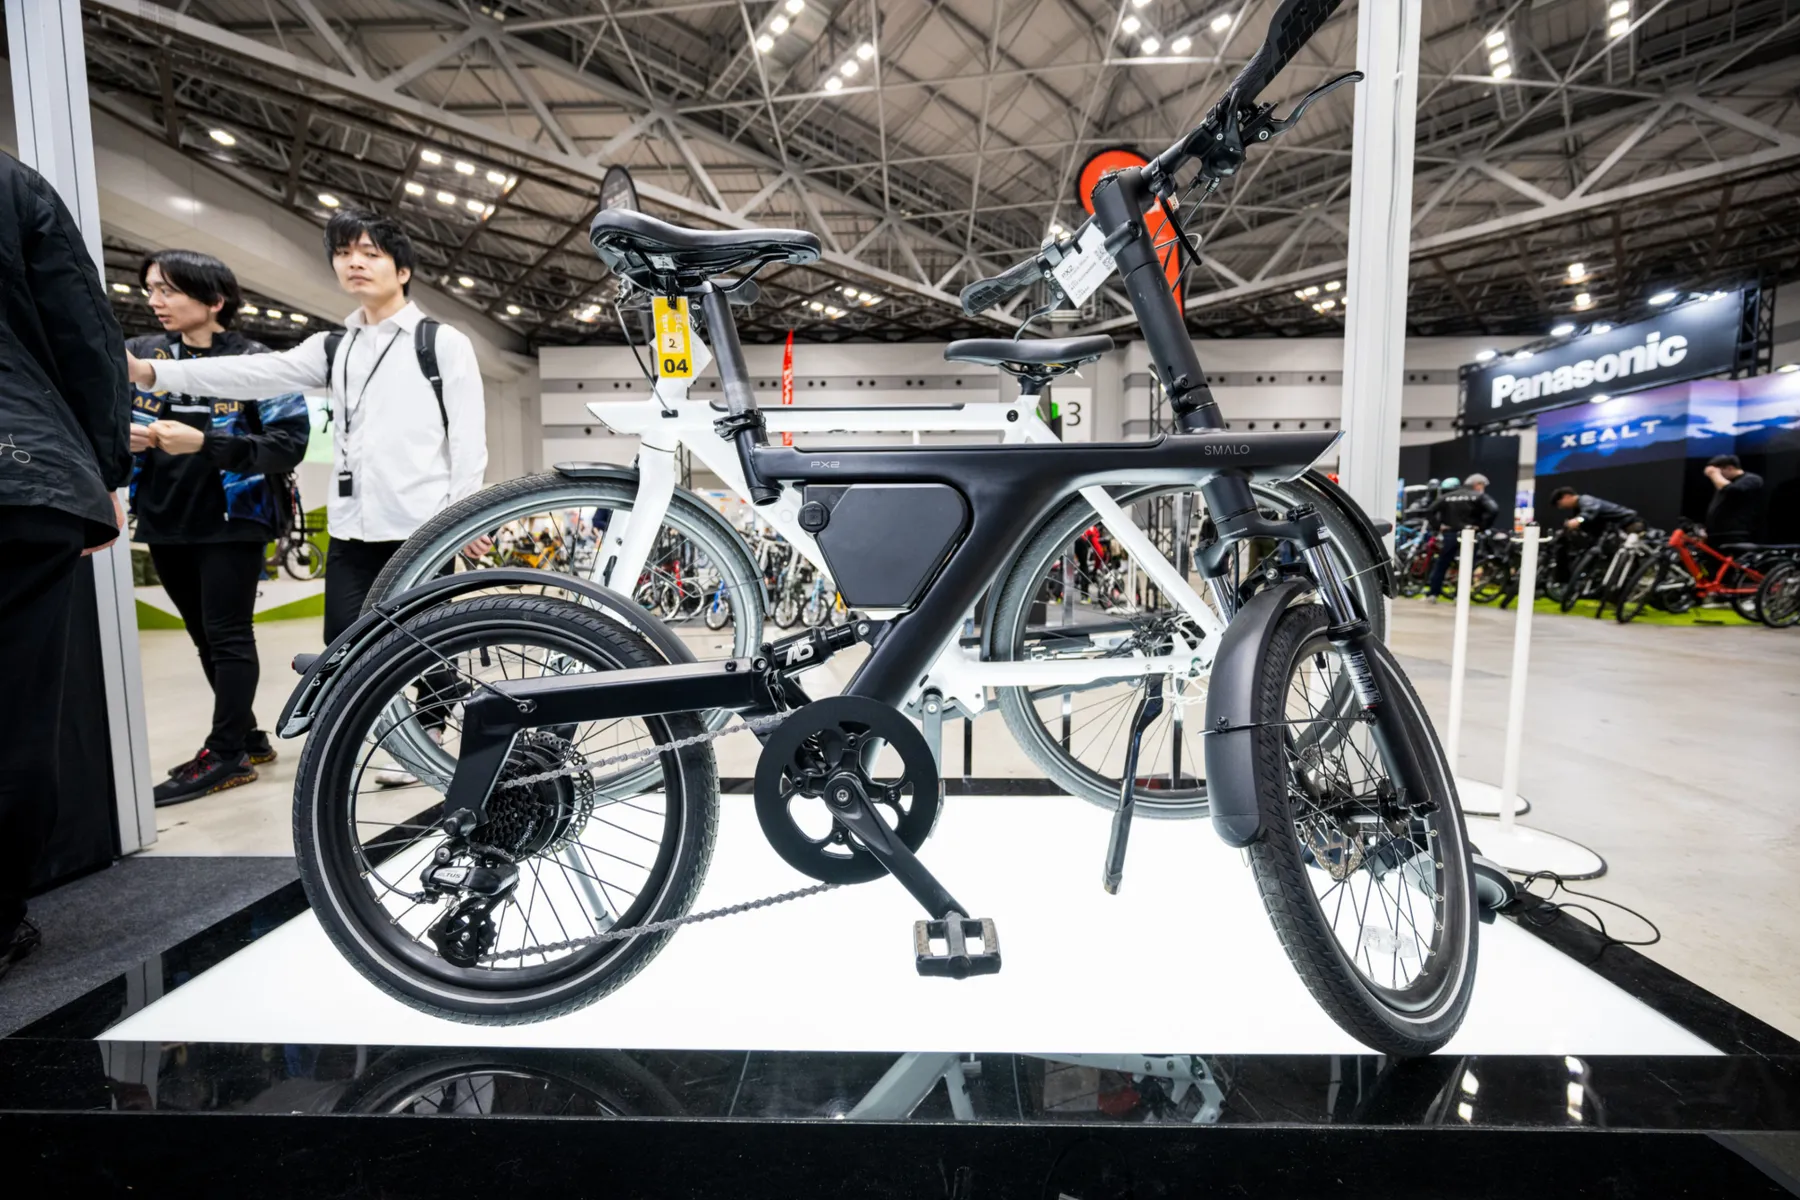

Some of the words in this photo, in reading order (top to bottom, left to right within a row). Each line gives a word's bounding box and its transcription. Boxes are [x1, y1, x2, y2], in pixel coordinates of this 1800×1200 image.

[668, 338, 677, 348] 2
[663, 358, 688, 373] 04
[1491, 332, 1688, 408] Panasonic
[1066, 401, 1081, 426] 3
[1561, 419, 1662, 448] XEALT
[1204, 444, 1250, 456] SMALO
